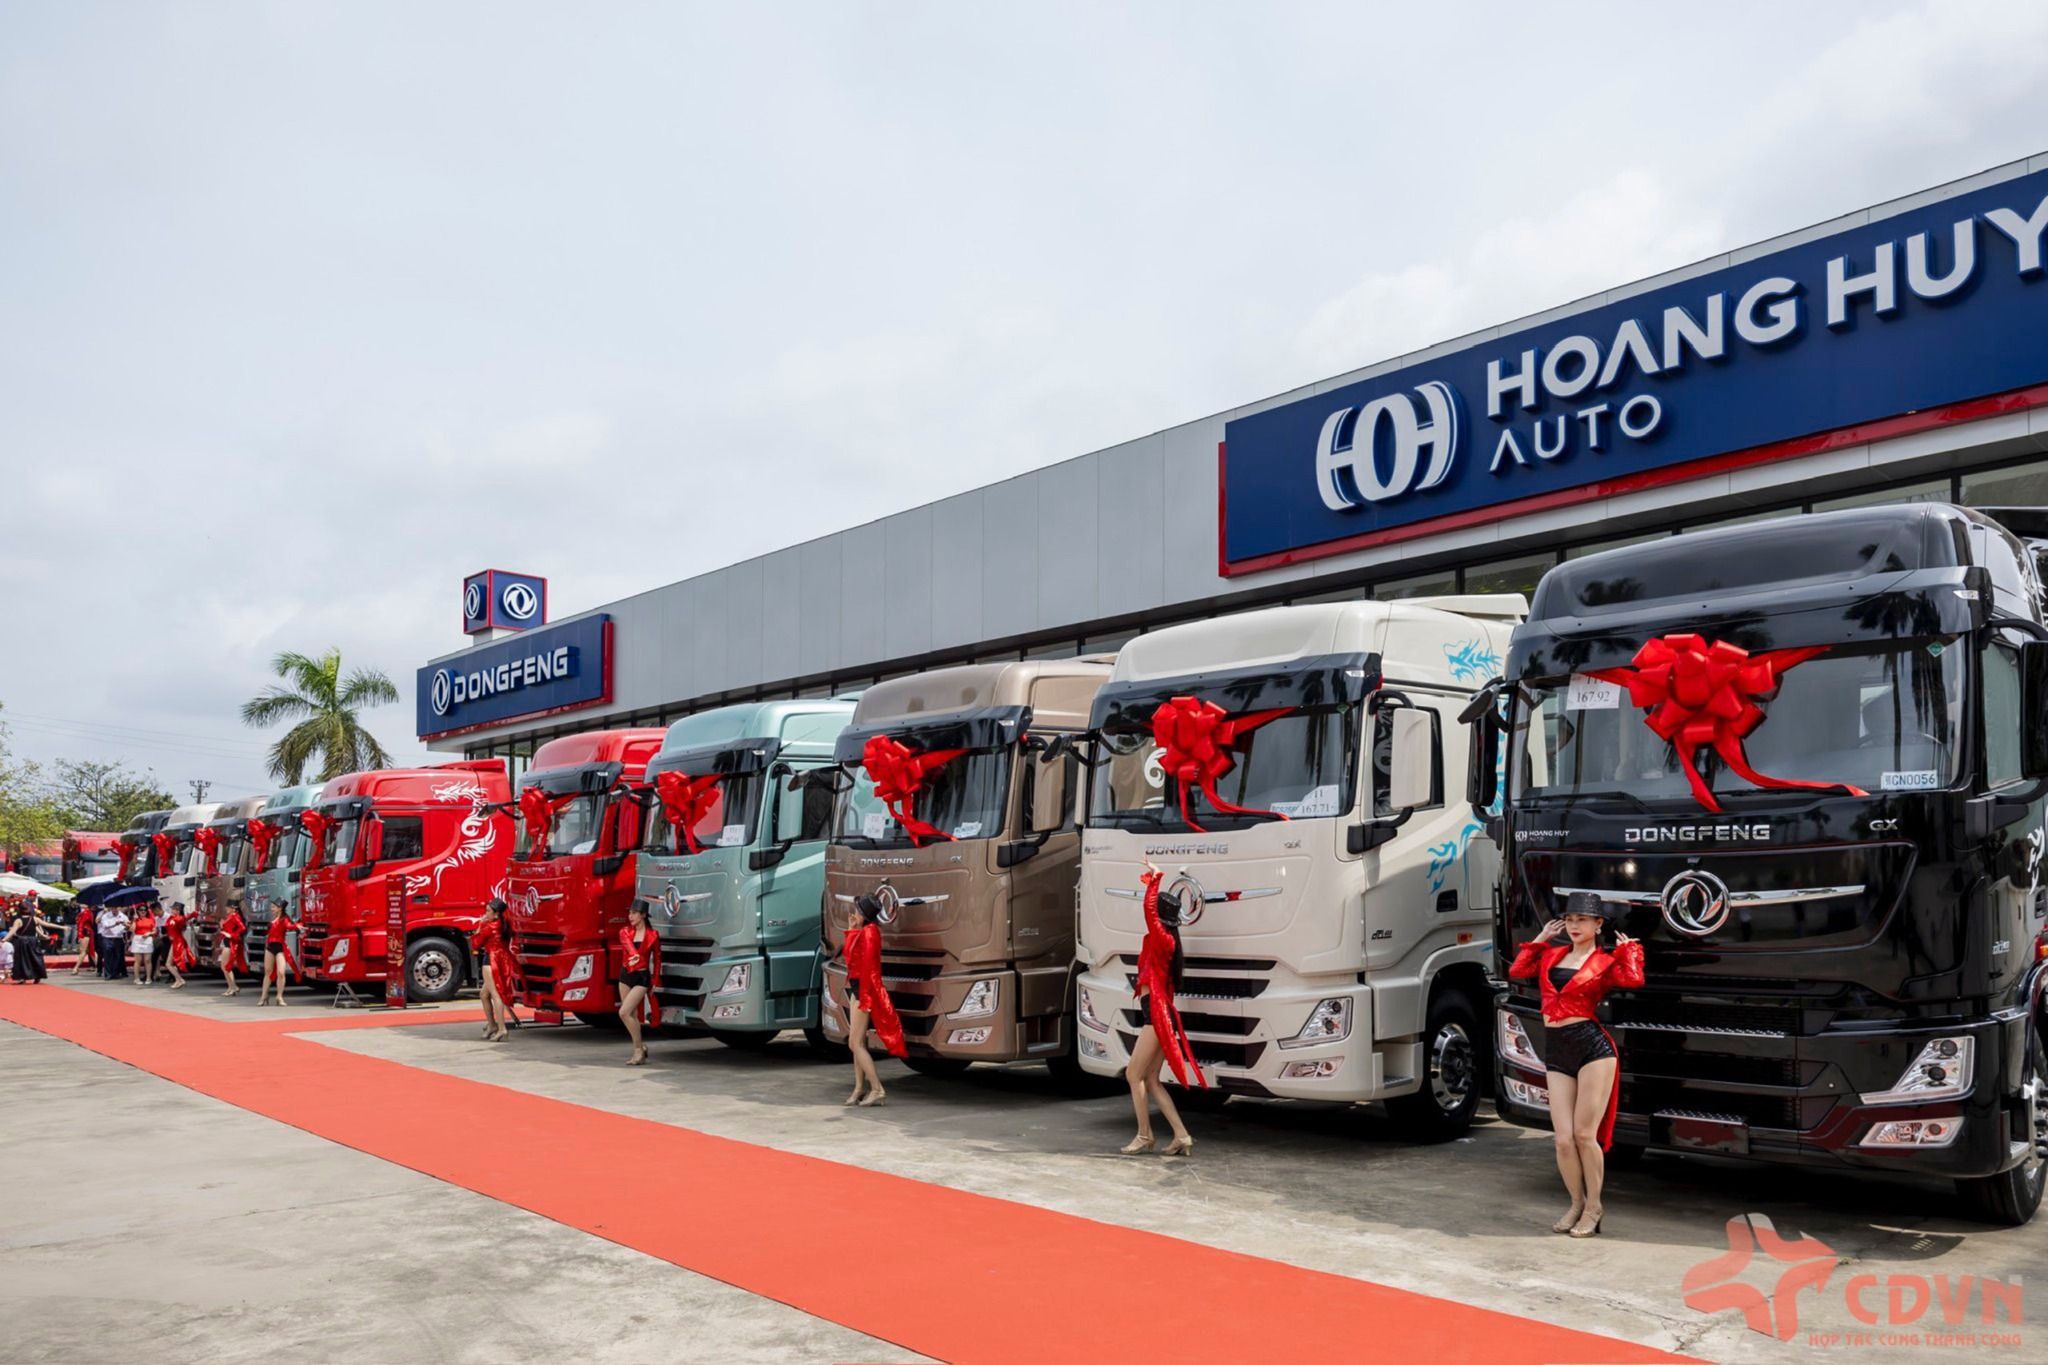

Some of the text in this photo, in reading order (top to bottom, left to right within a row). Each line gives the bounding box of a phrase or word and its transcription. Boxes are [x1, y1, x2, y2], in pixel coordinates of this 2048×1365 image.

[1487, 195, 2048, 418] HOANG HUY
[1490, 395, 1661, 473] AUTO
[454, 646, 568, 704] DONGFENG
[1625, 824, 1770, 843] DONGFENG
[1869, 818, 1898, 831] GX
[1145, 843, 1229, 856] DONGFENG
